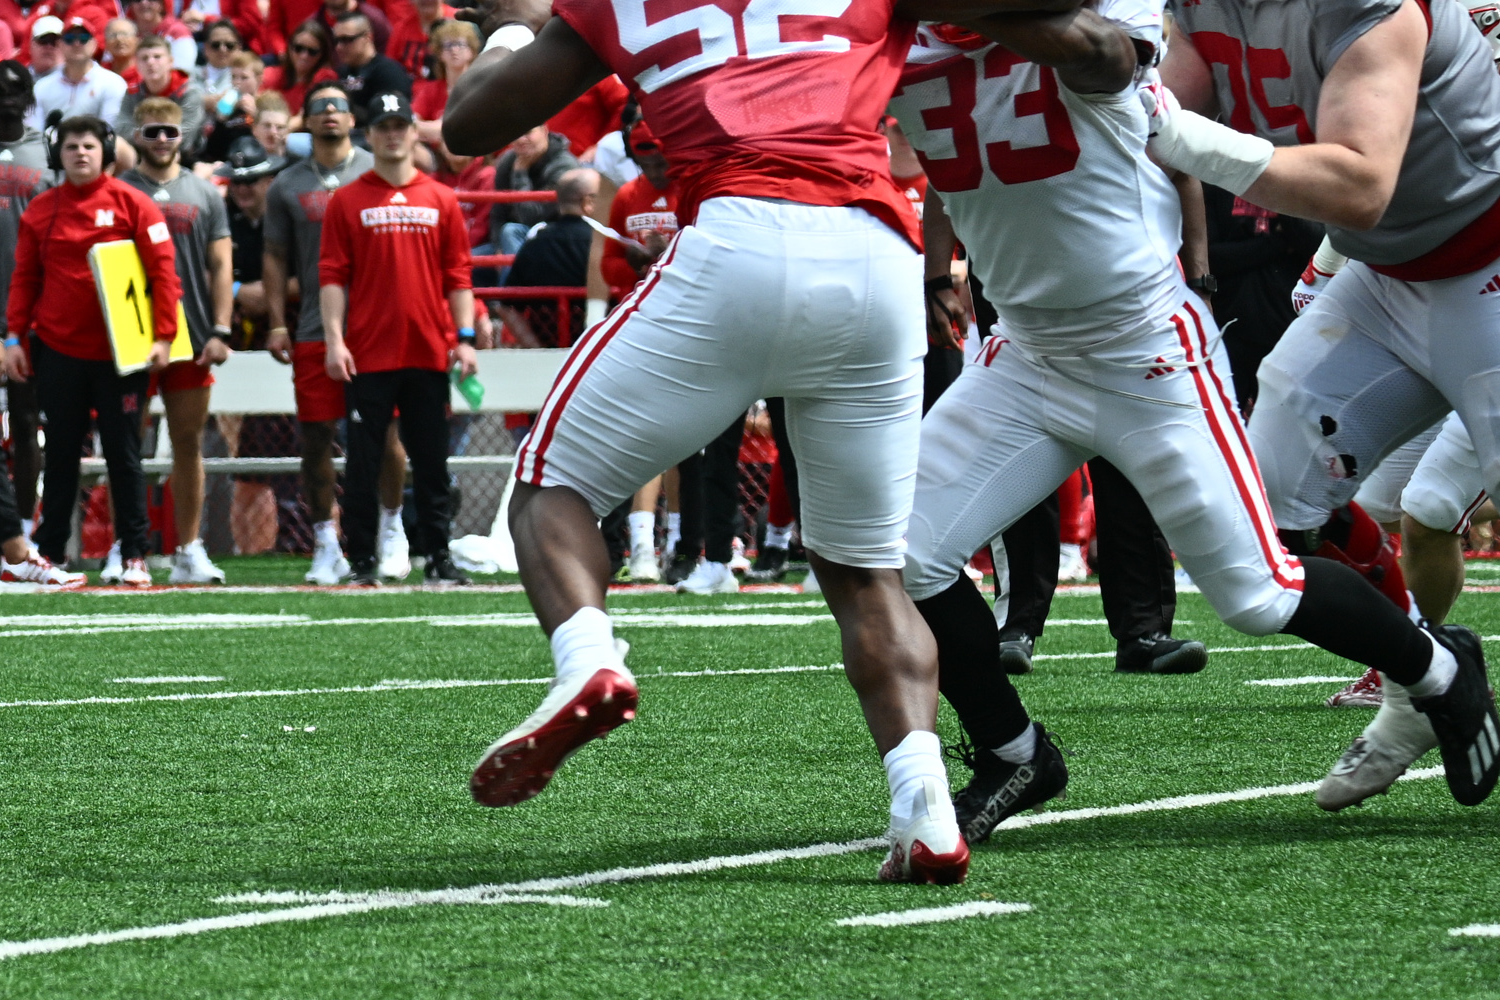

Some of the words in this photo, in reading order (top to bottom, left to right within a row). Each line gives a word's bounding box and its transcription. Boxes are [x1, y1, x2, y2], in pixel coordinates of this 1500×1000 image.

[381, 94, 401, 112] N
[891, 41, 1081, 194] 33
[94, 209, 115, 227] N
